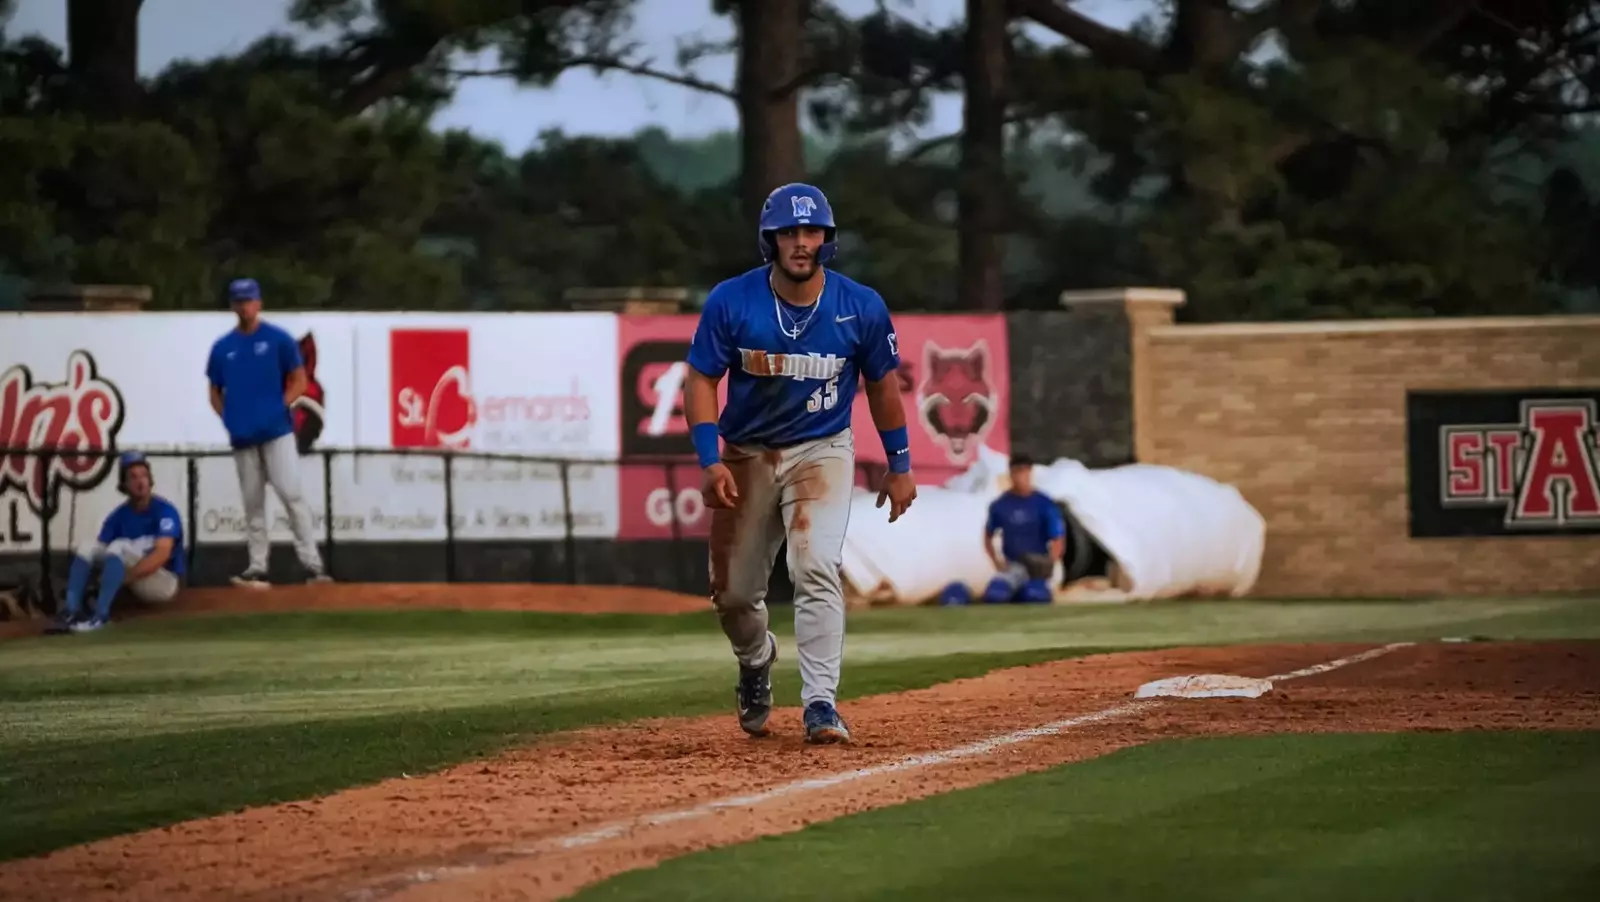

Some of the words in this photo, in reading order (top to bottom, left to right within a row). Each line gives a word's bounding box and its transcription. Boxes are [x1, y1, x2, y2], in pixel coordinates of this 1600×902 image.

[736, 346, 847, 382] Memphis
[806, 375, 840, 413] 35
[1444, 402, 1600, 520] STA
[645, 487, 705, 527] GO
